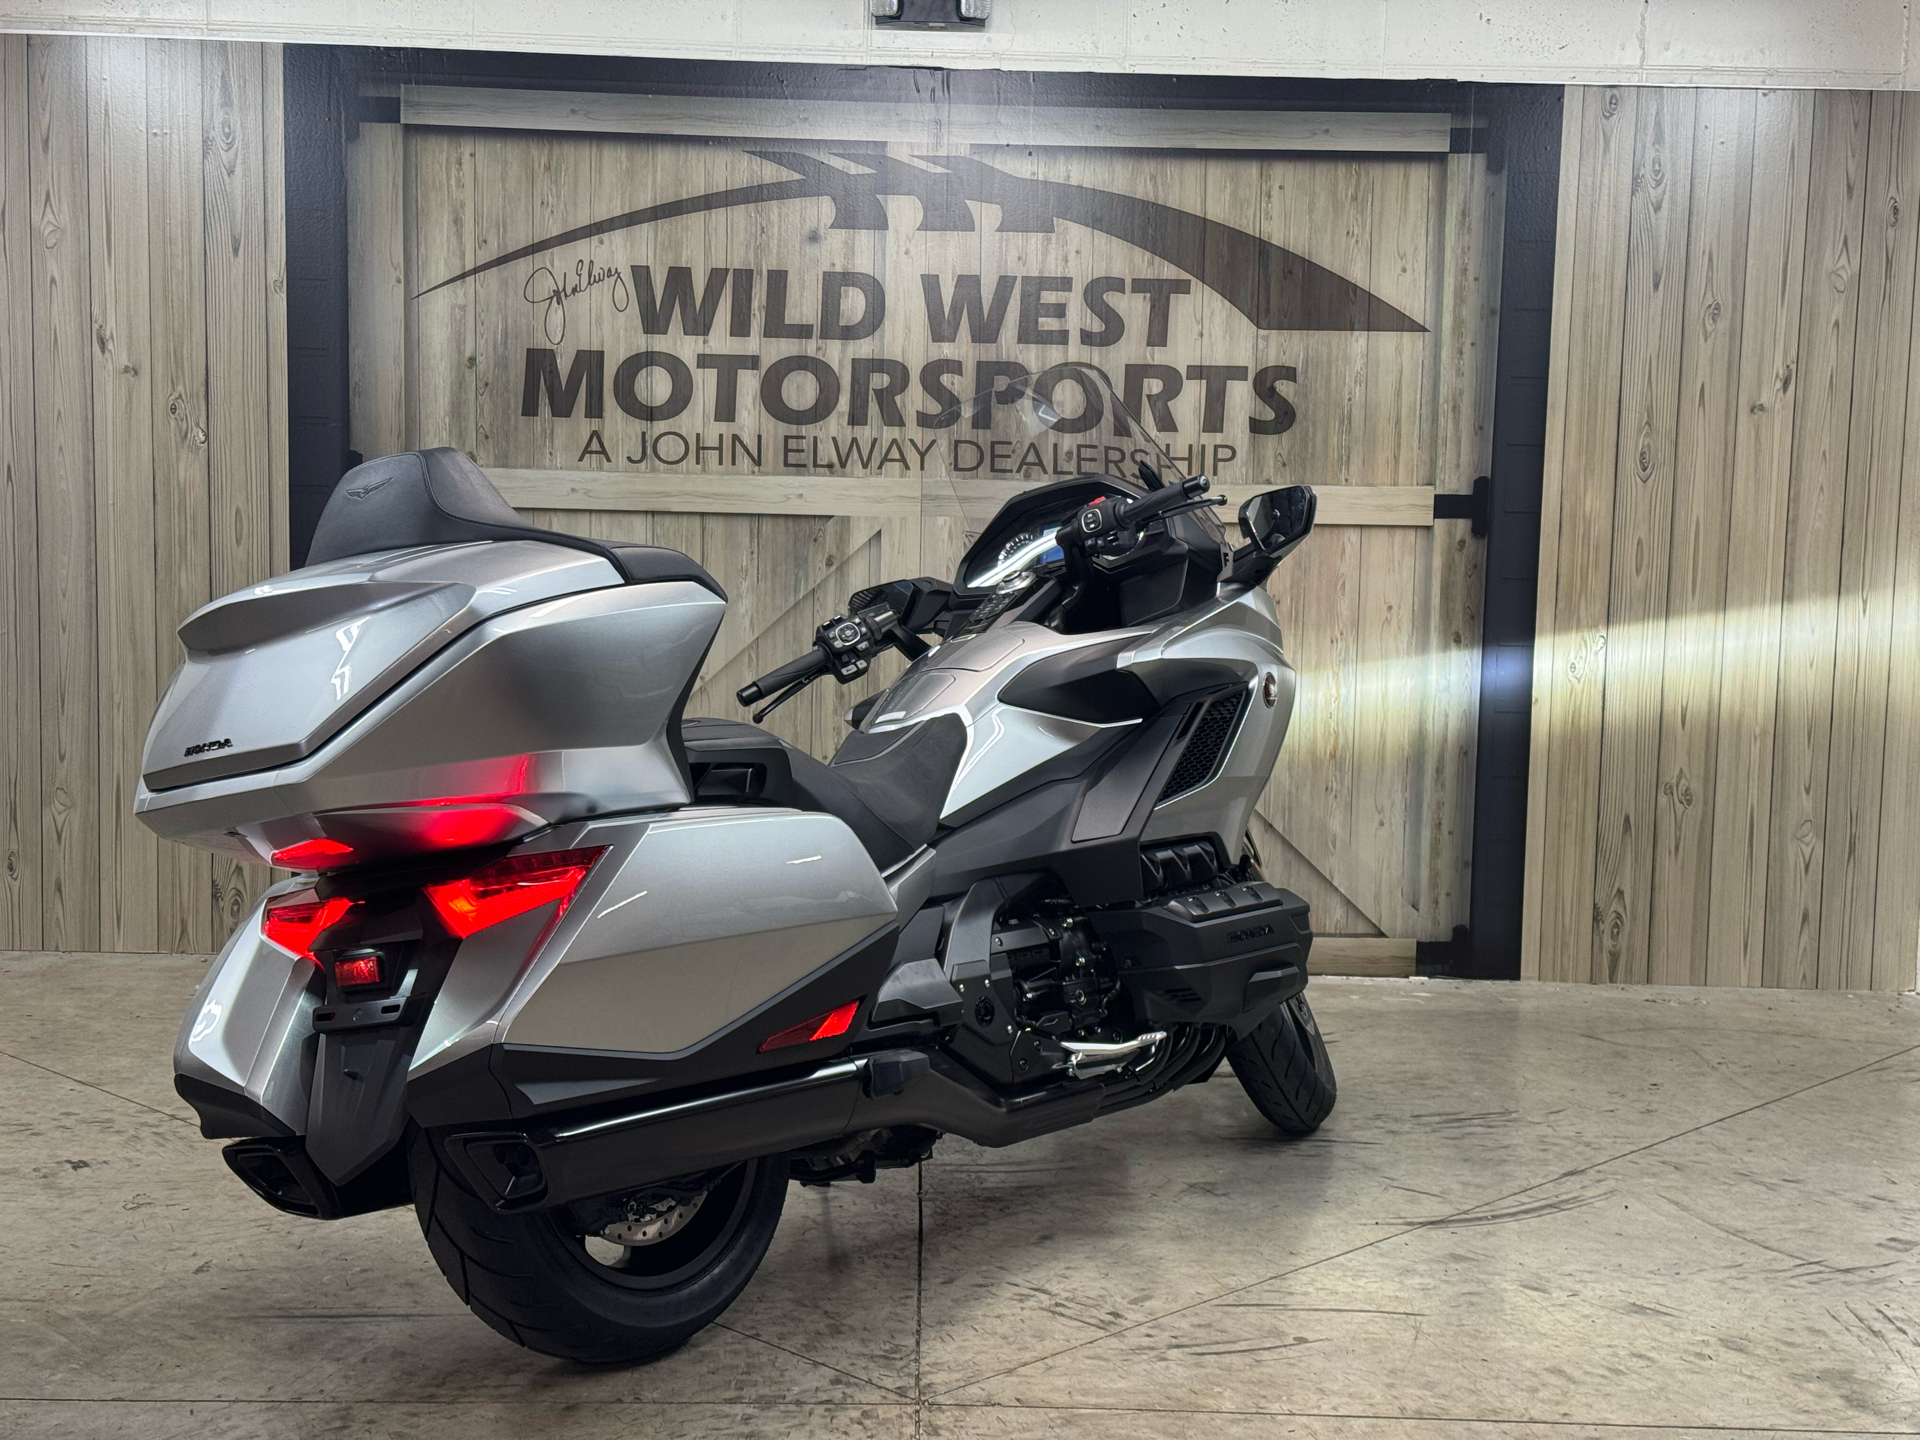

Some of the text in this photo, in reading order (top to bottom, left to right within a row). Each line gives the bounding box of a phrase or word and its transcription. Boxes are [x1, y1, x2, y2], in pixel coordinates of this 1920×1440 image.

[630, 264, 1191, 348] WILD WEST
[520, 347, 1298, 437] MOTORSPORTS
[578, 429, 1238, 479] A JOHN ELWAY DEALERSHIP
[1226, 923, 1275, 943] HONDA
